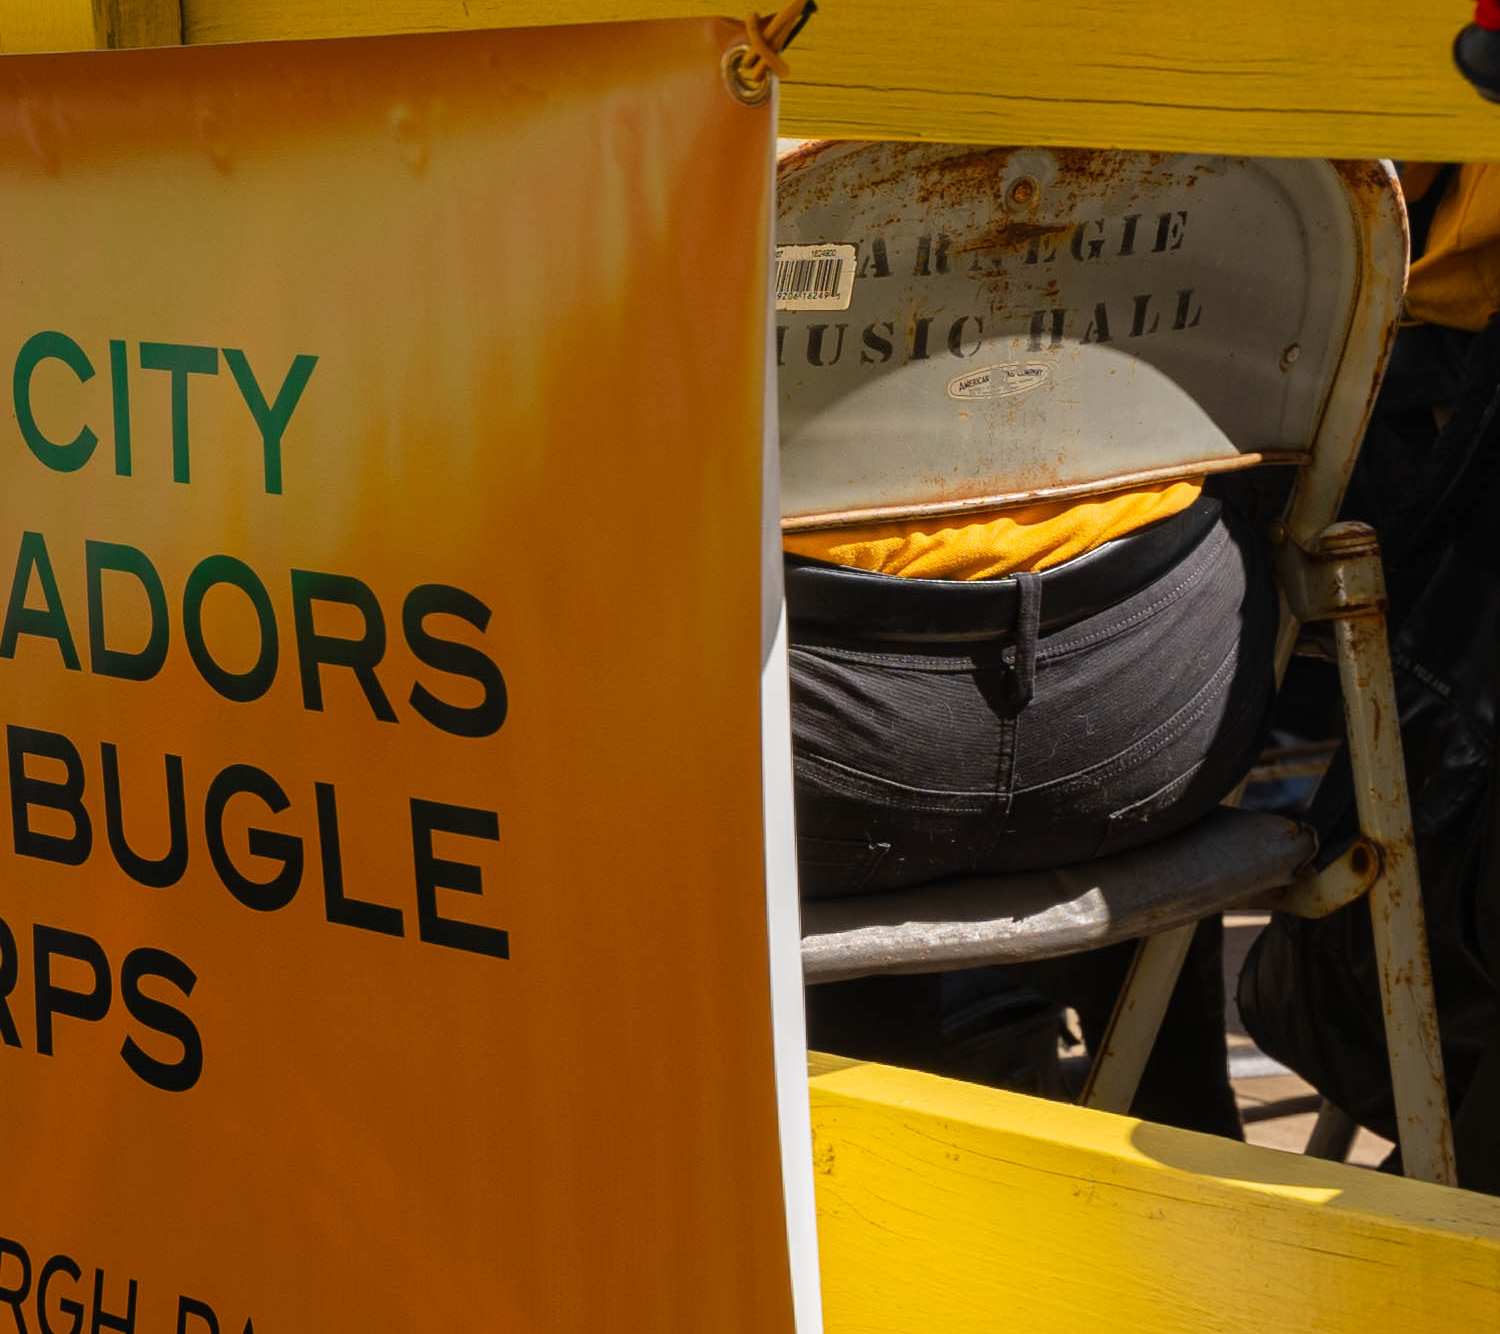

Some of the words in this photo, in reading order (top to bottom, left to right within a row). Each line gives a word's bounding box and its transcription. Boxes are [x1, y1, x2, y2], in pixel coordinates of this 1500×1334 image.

[855, 210, 1188, 279] AREGIE
[1027, 288, 1203, 353] HALL
[13, 331, 319, 495] CITY
[7, 725, 509, 960] BUGLE
